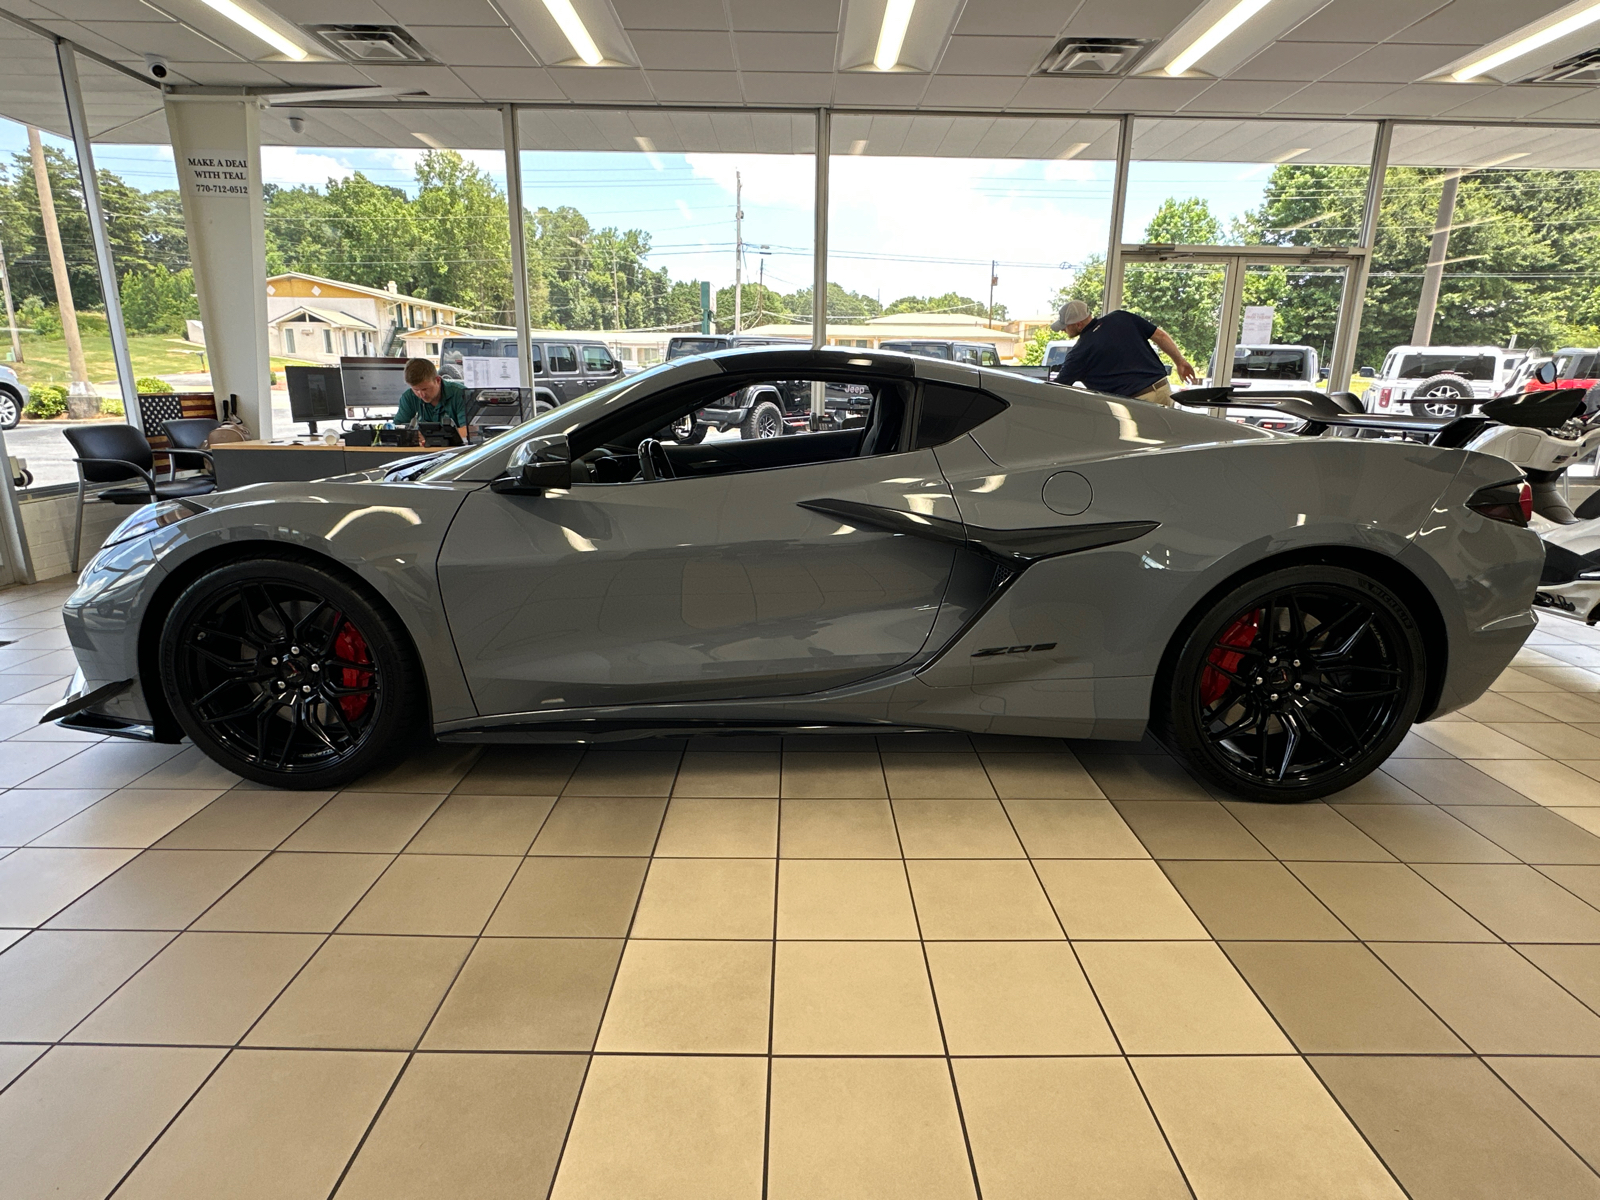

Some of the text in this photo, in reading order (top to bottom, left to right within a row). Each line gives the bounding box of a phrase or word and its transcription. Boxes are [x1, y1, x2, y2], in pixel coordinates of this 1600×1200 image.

[188, 158, 215, 167] MAKE
[217, 159, 223, 167] A
[194, 170, 246, 180] WITH TEAL
[196, 184, 248, 194] 770-712-0512
[845, 384, 865, 395] Jeep
[1371, 585, 1412, 629] MICHELIN
